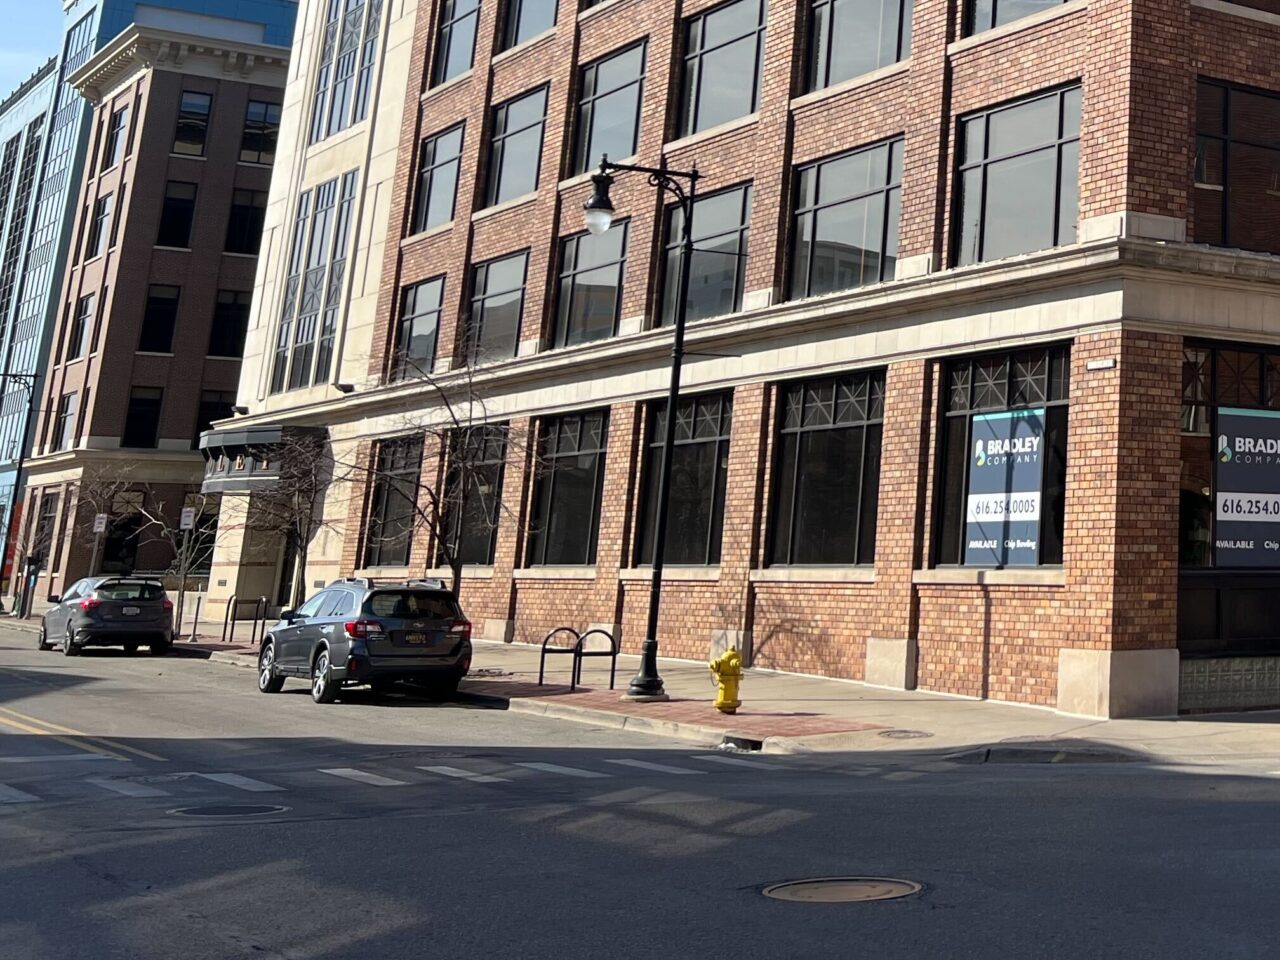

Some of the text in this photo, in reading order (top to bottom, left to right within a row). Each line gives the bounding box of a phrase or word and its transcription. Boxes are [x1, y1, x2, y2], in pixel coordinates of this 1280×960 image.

[987, 436, 1040, 454] BRADLEY
[975, 499, 1036, 515] 616.254.0005
[1216, 540, 1255, 549] AVAILABLE
[1264, 540, 1279, 551] Chip
